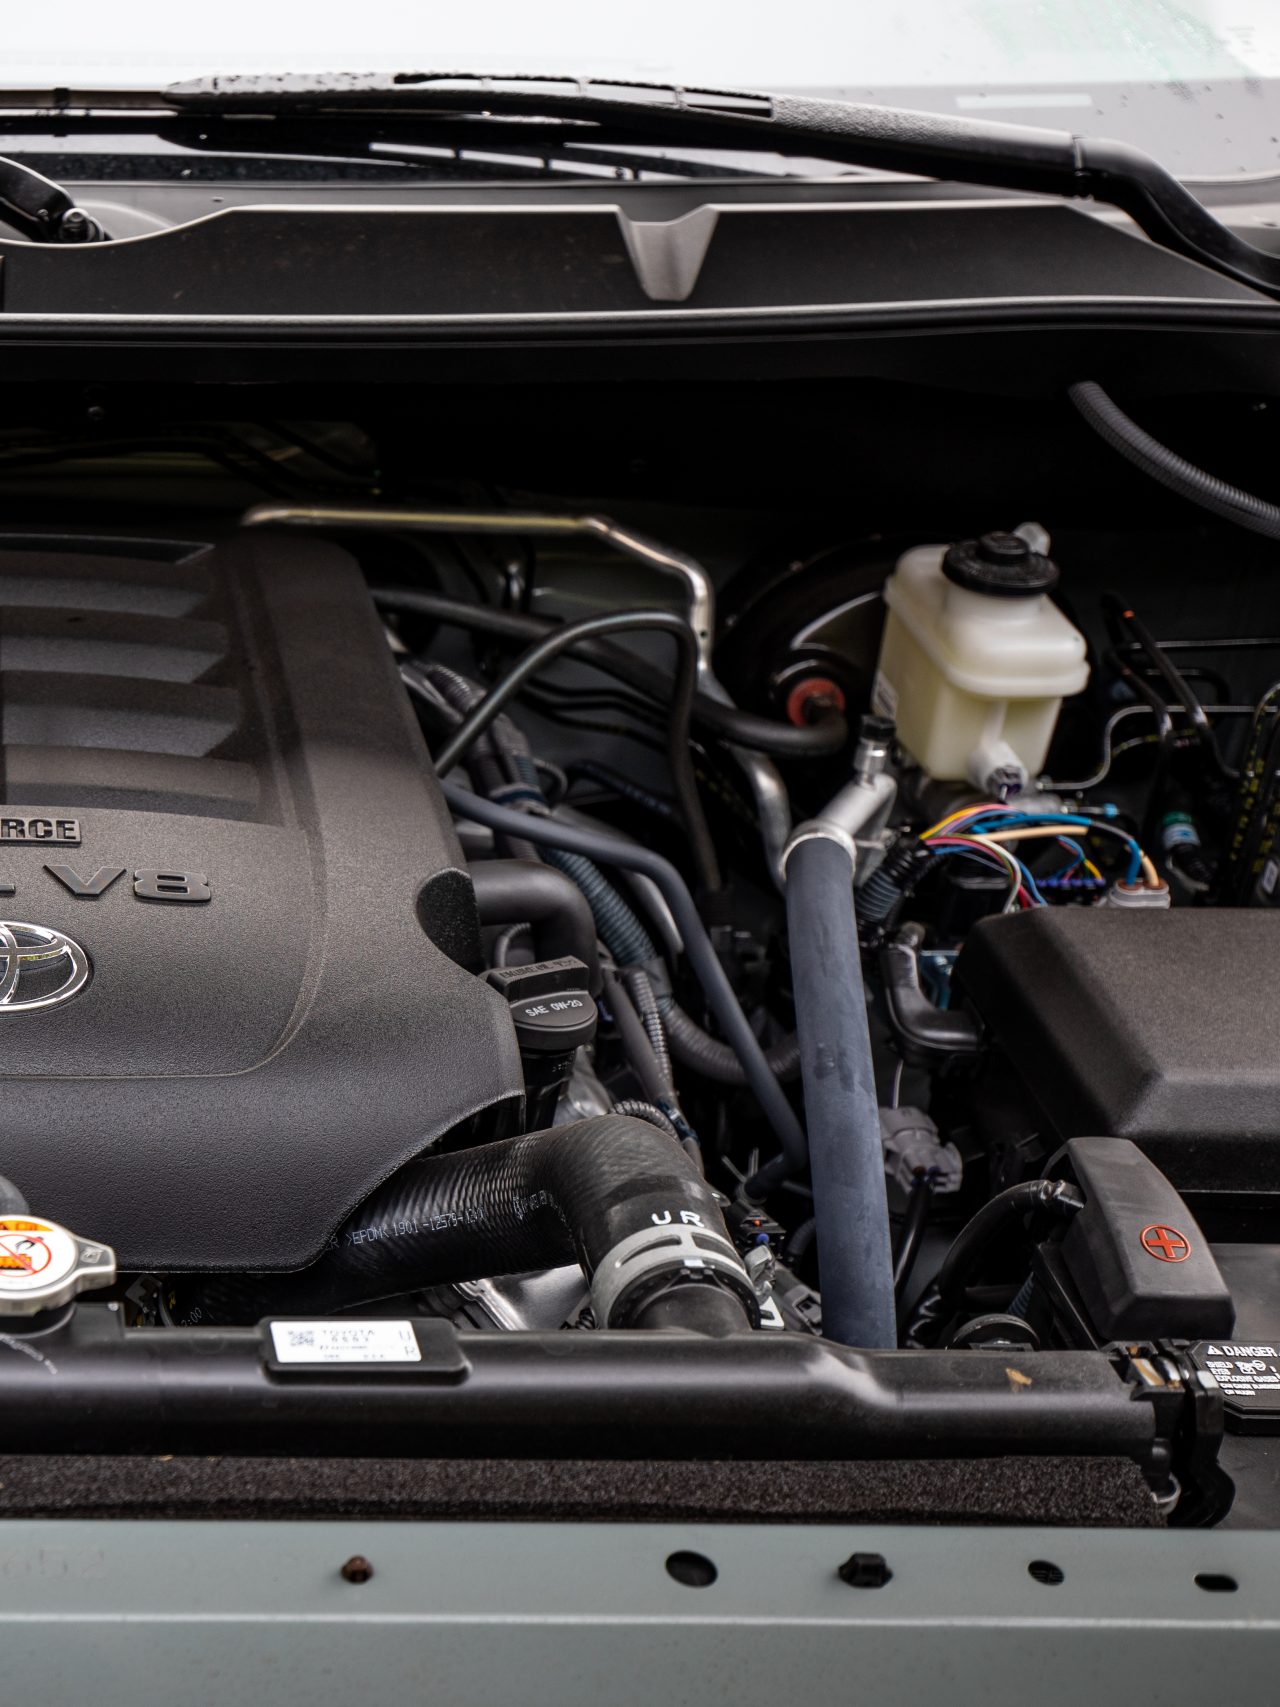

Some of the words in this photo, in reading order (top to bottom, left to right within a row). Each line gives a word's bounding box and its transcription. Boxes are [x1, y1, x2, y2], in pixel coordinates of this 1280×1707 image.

[42, 864, 212, 903] V8
[525, 1005, 549, 1017] SAE
[550, 1000, 583, 1011] 0W-20
[393, 1217, 419, 1237] 1901
[1222, 1345, 1278, 1357] DANGER
